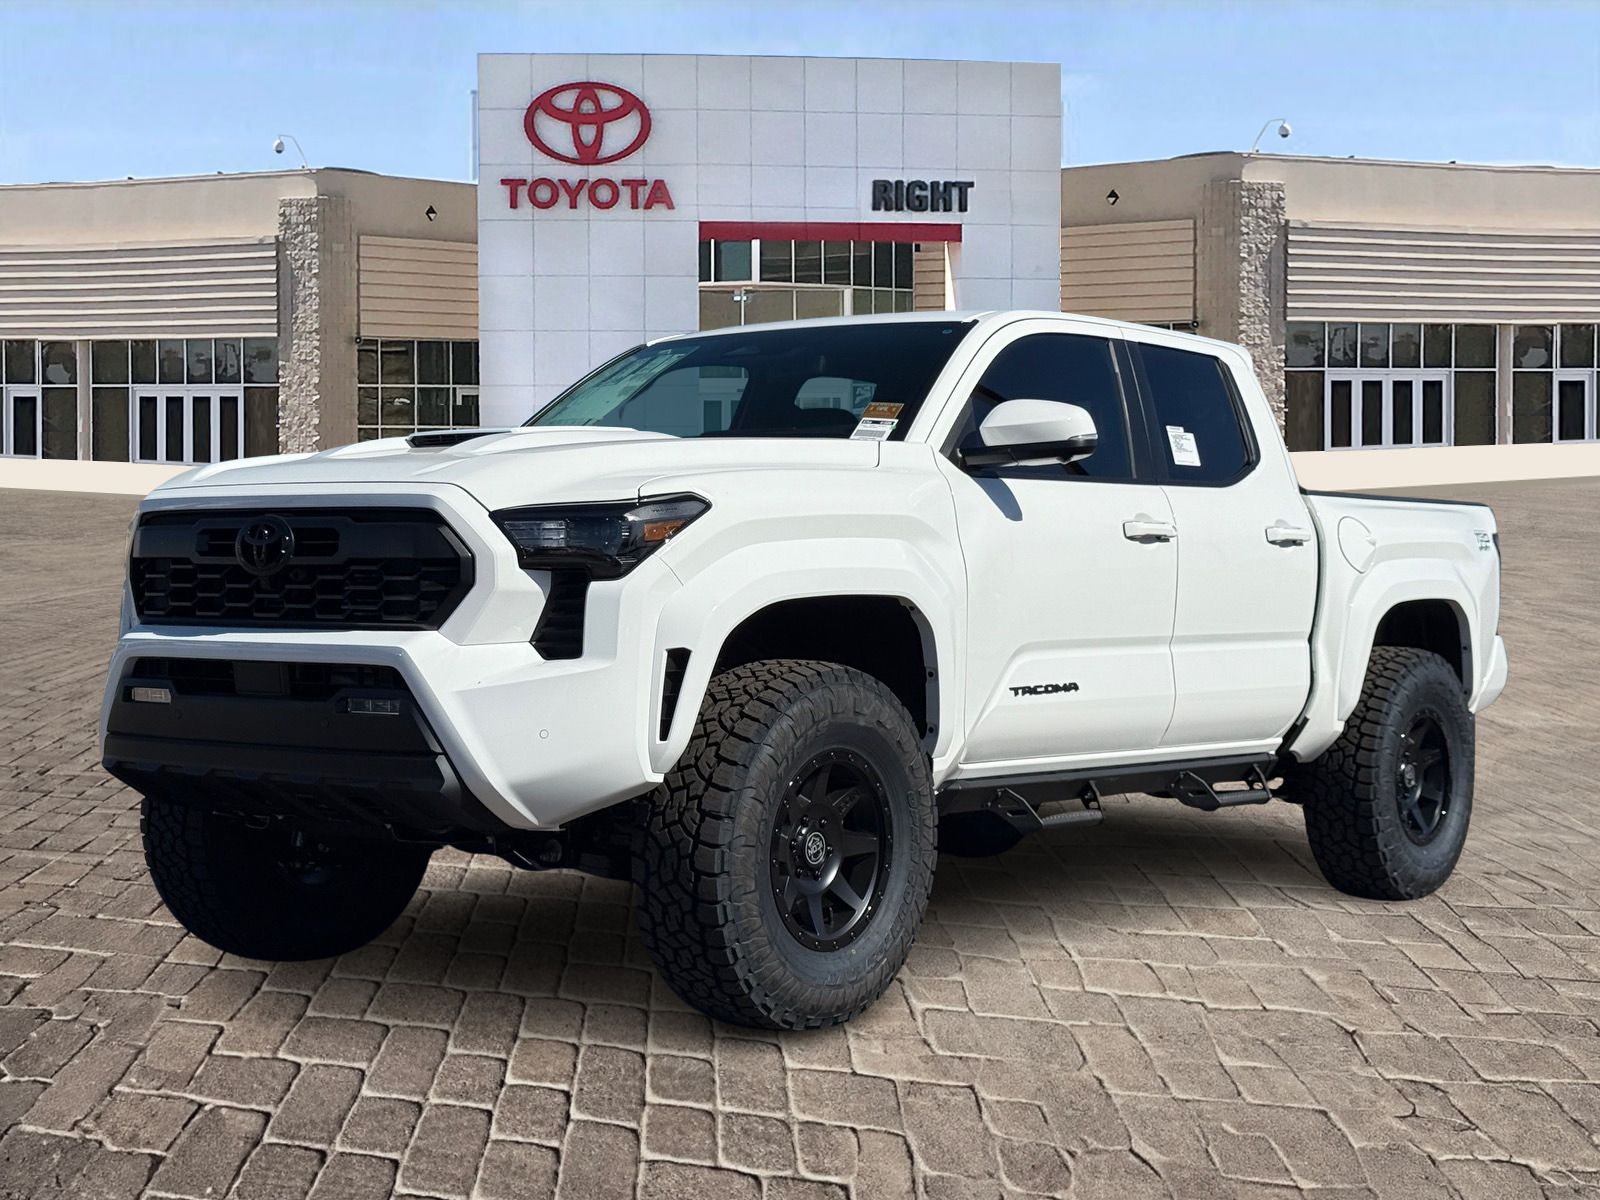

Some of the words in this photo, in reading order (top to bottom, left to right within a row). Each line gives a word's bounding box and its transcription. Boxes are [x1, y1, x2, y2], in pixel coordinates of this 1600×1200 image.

[500, 178, 675, 209] TOYOTA
[872, 180, 974, 212] RIGHT
[1009, 682, 1079, 697] TACOMA
